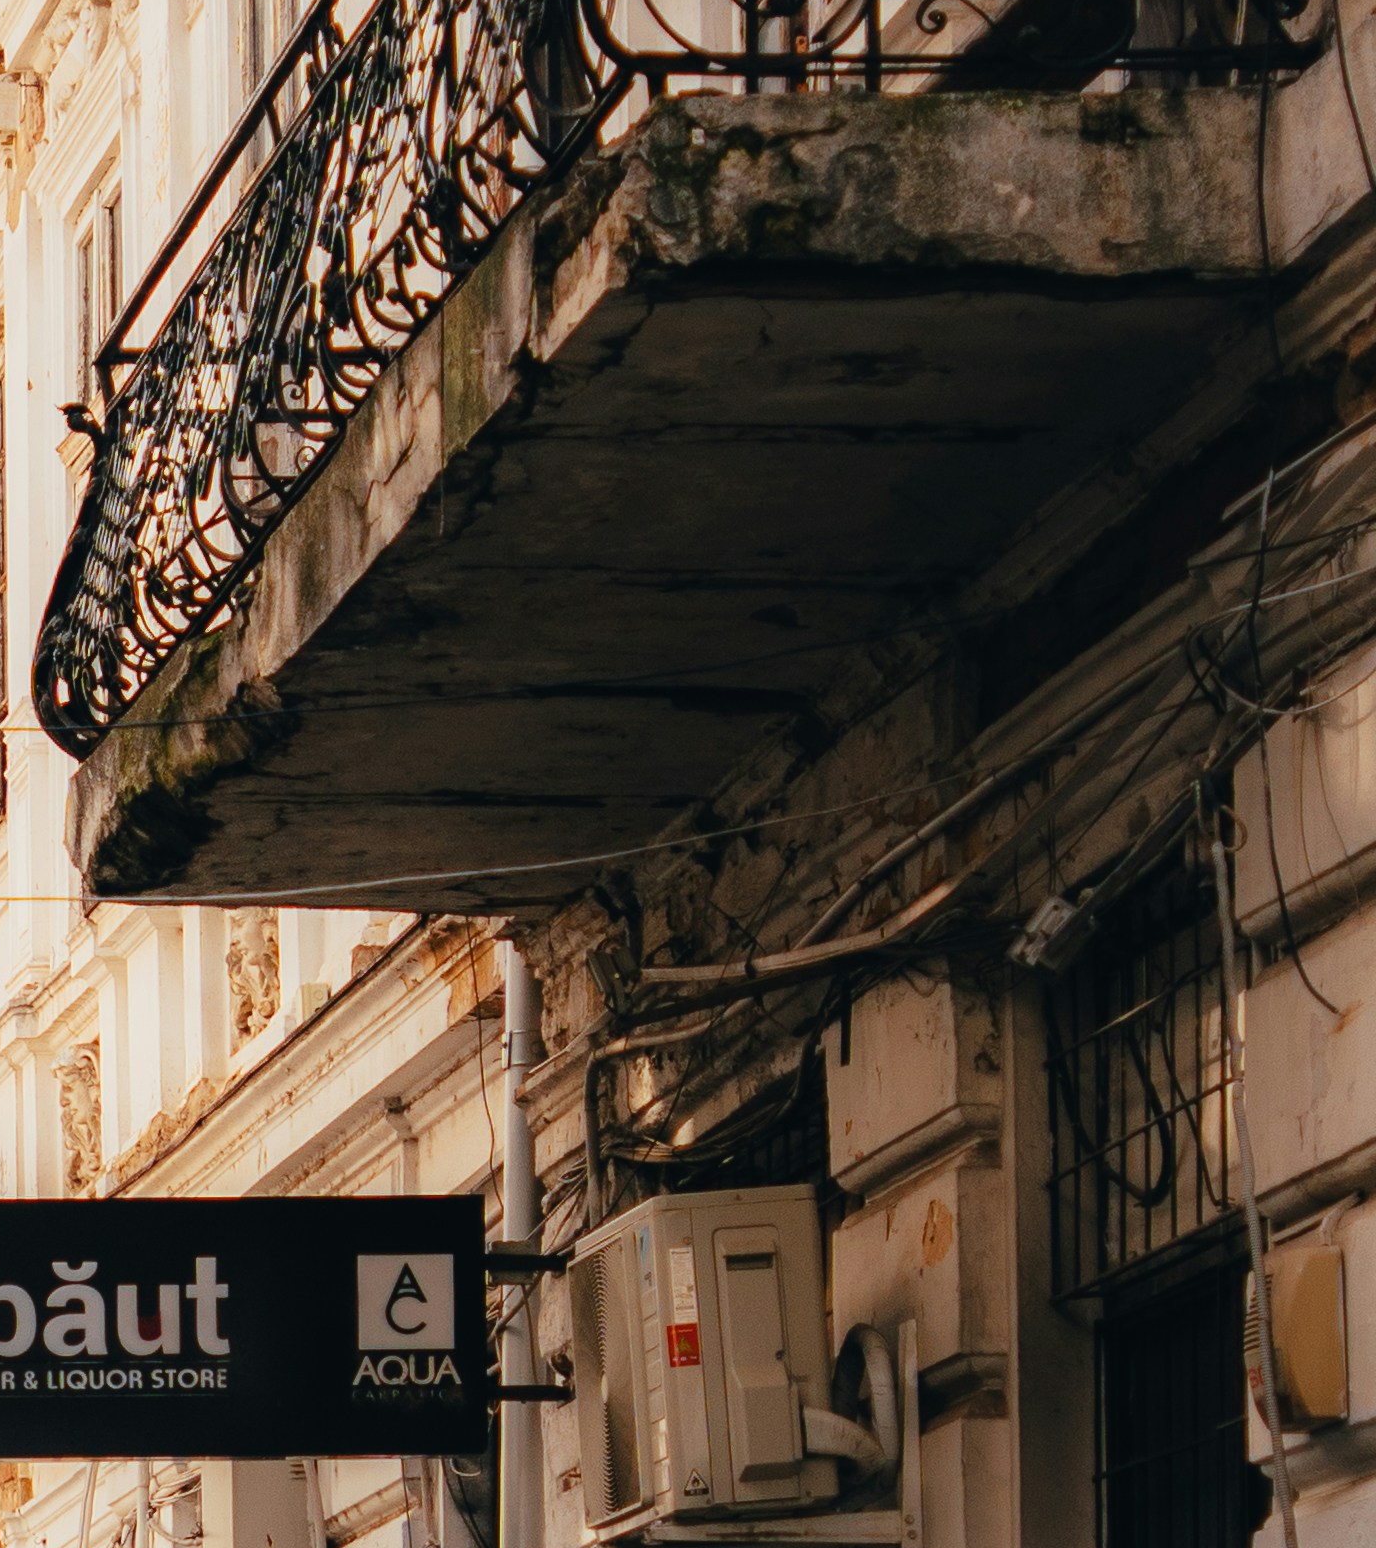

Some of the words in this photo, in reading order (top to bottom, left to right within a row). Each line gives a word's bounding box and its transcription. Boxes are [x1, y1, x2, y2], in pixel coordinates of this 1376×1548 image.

[23, 1369, 39, 1390] &
[46, 1368, 144, 1391] LIQUOR
[150, 1368, 228, 1389] STORE
[351, 1354, 463, 1387] AQUA
